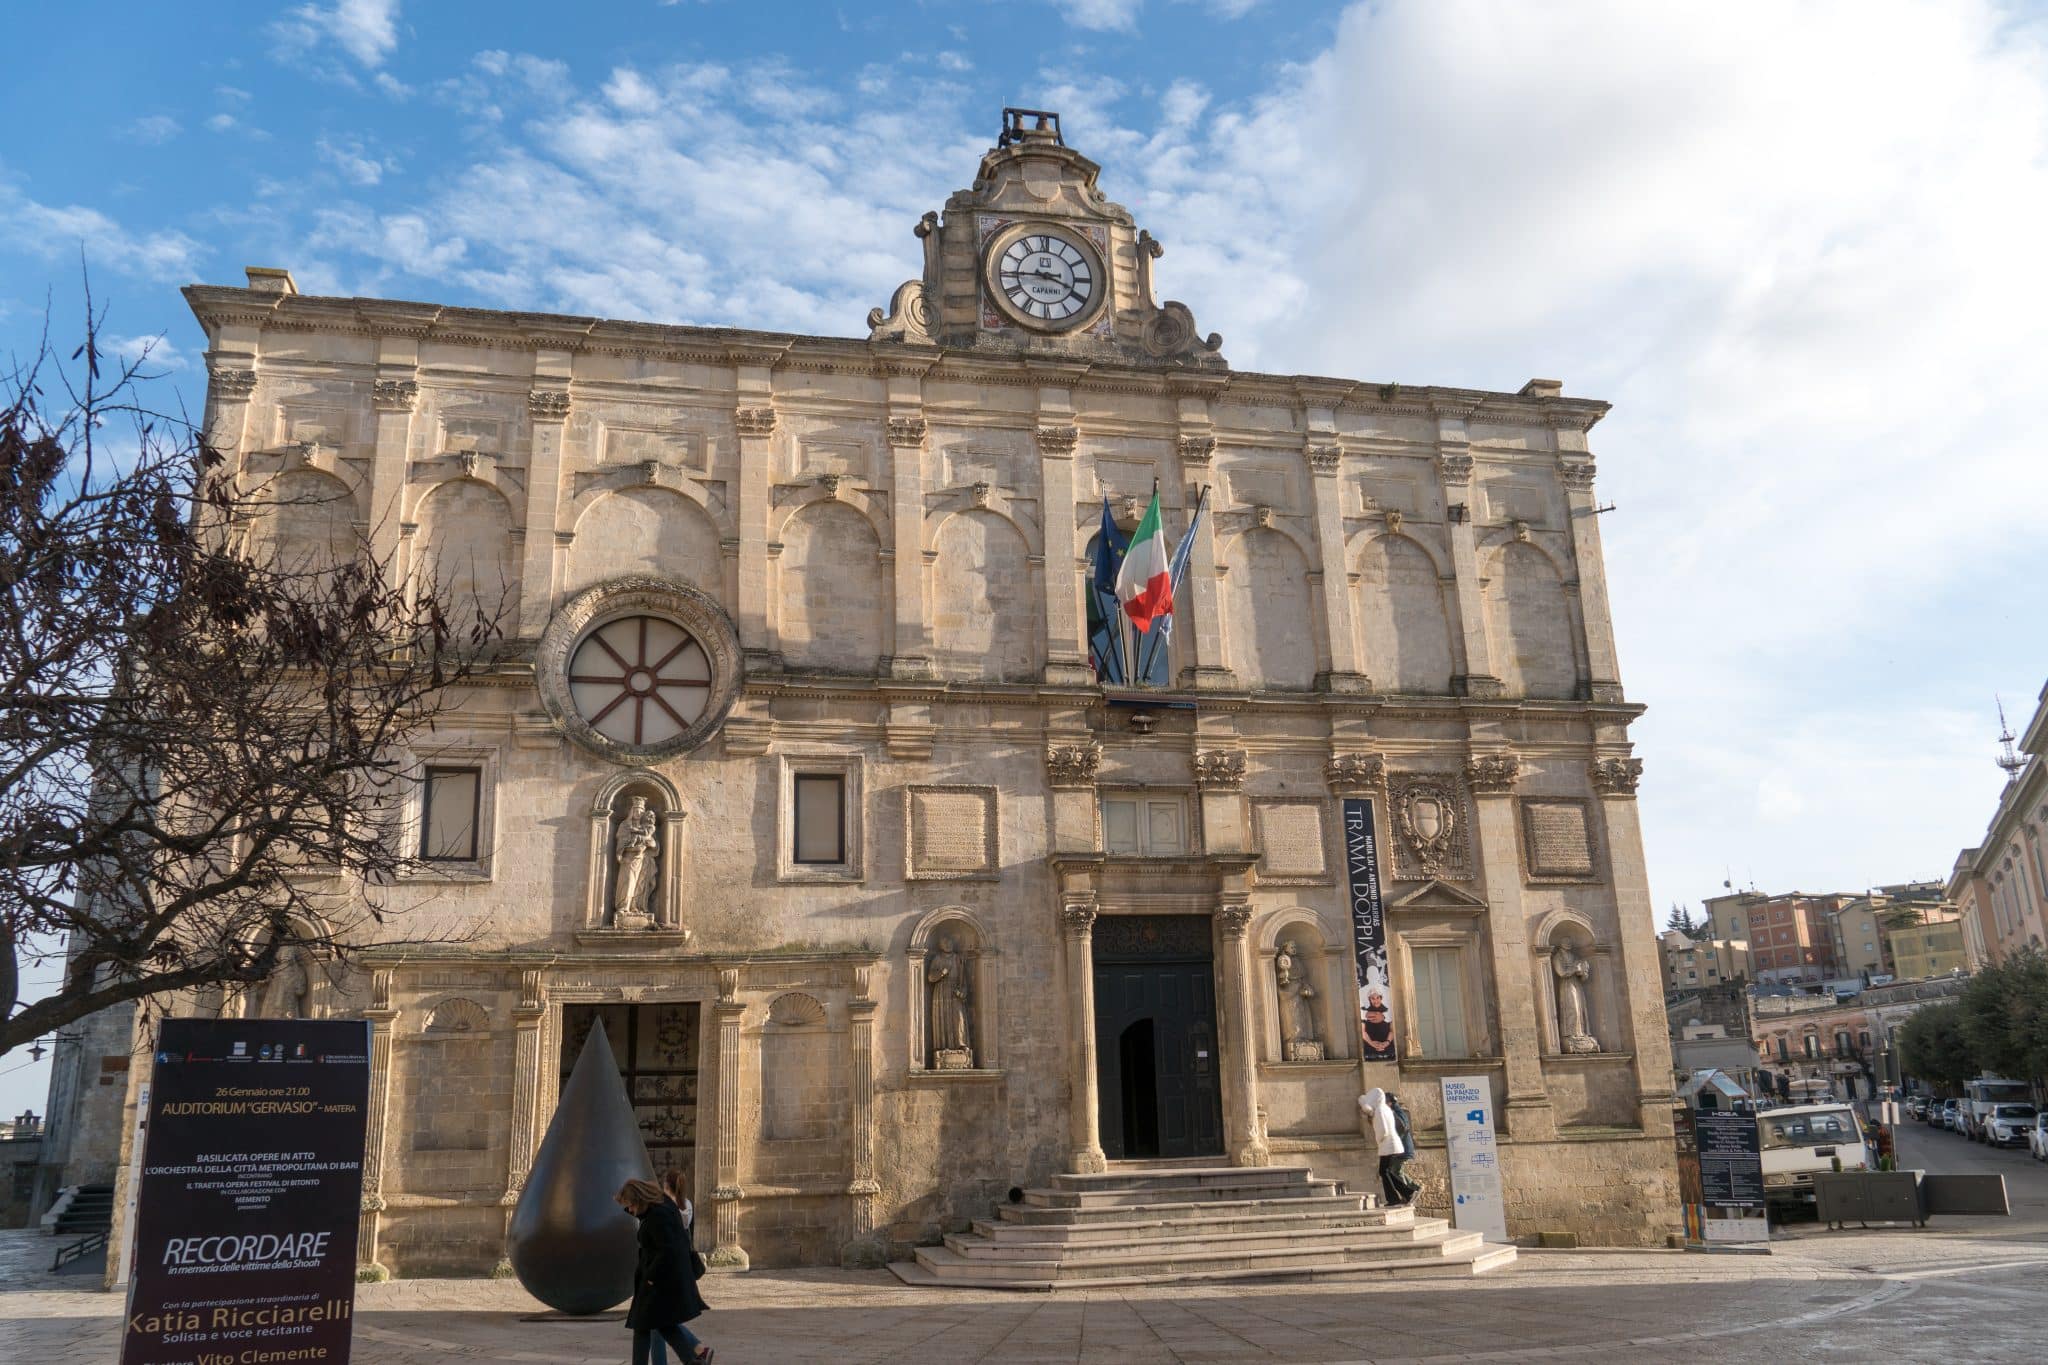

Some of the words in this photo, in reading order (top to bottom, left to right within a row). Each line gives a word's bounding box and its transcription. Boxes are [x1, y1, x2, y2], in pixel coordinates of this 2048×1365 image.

[1032, 286, 1061, 295] CAPANNI
[1346, 806, 1367, 874] TRAMA
[1365, 835, 1373, 854] MARIA
[1368, 873, 1378, 900] ANTONIO
[1352, 882, 1374, 956] DOPPIA
[216, 1087, 227, 1097] 26
[228, 1087, 268, 1097] Gennaio
[162, 1102, 246, 1115] AUDITORIUM
[324, 1104, 356, 1113] MATERA
[197, 1154, 248, 1163] BASILICATA
[250, 1153, 279, 1161] OPERE
[281, 1153, 291, 1161] IN
[292, 1152, 315, 1160] ATTO
[145, 1165, 203, 1175] L'ORCHESTRA
[205, 1165, 232, 1174] DELLA
[259, 1163, 328, 1172] METROPOLITANA
[330, 1162, 339, 1170] DI
[225, 1180, 249, 1188] OPERA
[250, 1180, 281, 1188] FESTIVAL
[163, 1231, 331, 1265] RECORDARE
[168, 1265, 177, 1274] in
[178, 1263, 218, 1274] memoria
[219, 1262, 240, 1272] delle
[241, 1260, 271, 1271] vittime
[272, 1259, 293, 1269] della
[293, 1258, 320, 1269] Shoah
[162, 1302, 180, 1310] Con
[192, 1298, 254, 1309] partecipazione
[256, 1294, 310, 1304] straordinaria
[127, 1310, 200, 1334] Katia
[212, 1300, 350, 1329] Ricciarelli
[163, 1332, 207, 1344] Solista
[210, 1332, 219, 1341] e
[223, 1330, 252, 1340] voce
[257, 1324, 313, 1337] recitante
[197, 1351, 234, 1365] Vito
[240, 1347, 328, 1365] Clemente
